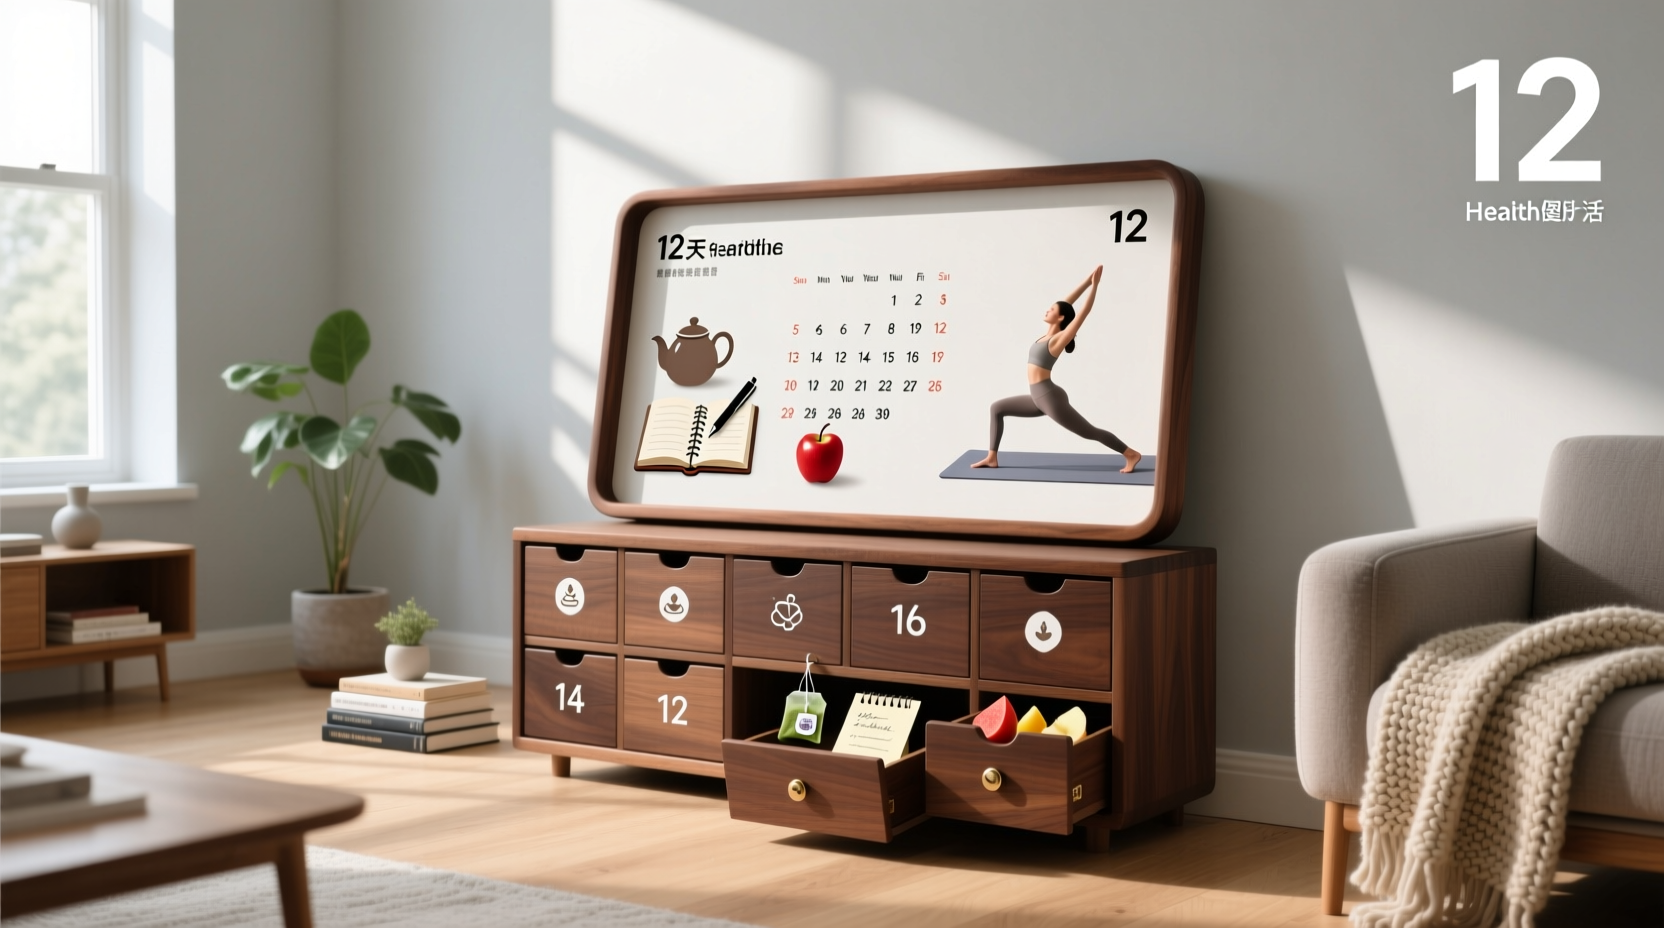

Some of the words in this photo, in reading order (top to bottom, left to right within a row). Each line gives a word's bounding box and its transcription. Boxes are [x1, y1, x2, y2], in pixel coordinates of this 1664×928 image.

[1109, 208, 1148, 244] 12
[890, 294, 897, 307] 1
[914, 293, 923, 306] 2
[792, 323, 800, 336] 5
[839, 323, 848, 336] 6
[863, 322, 872, 336] 7
[887, 322, 896, 335] 8
[909, 321, 923, 335] 19
[933, 321, 947, 335] 12
[810, 351, 823, 364] 14
[834, 350, 848, 364] 12
[858, 351, 872, 364] 14
[882, 351, 895, 364] 15
[906, 350, 920, 364] 16
[931, 350, 945, 363] 19
[829, 379, 845, 392] 20
[854, 379, 867, 392] 21
[877, 379, 893, 393] 22
[902, 379, 918, 393] 27
[891, 604, 926, 637] 16
[555, 682, 585, 714] 14
[657, 694, 688, 726] 12
